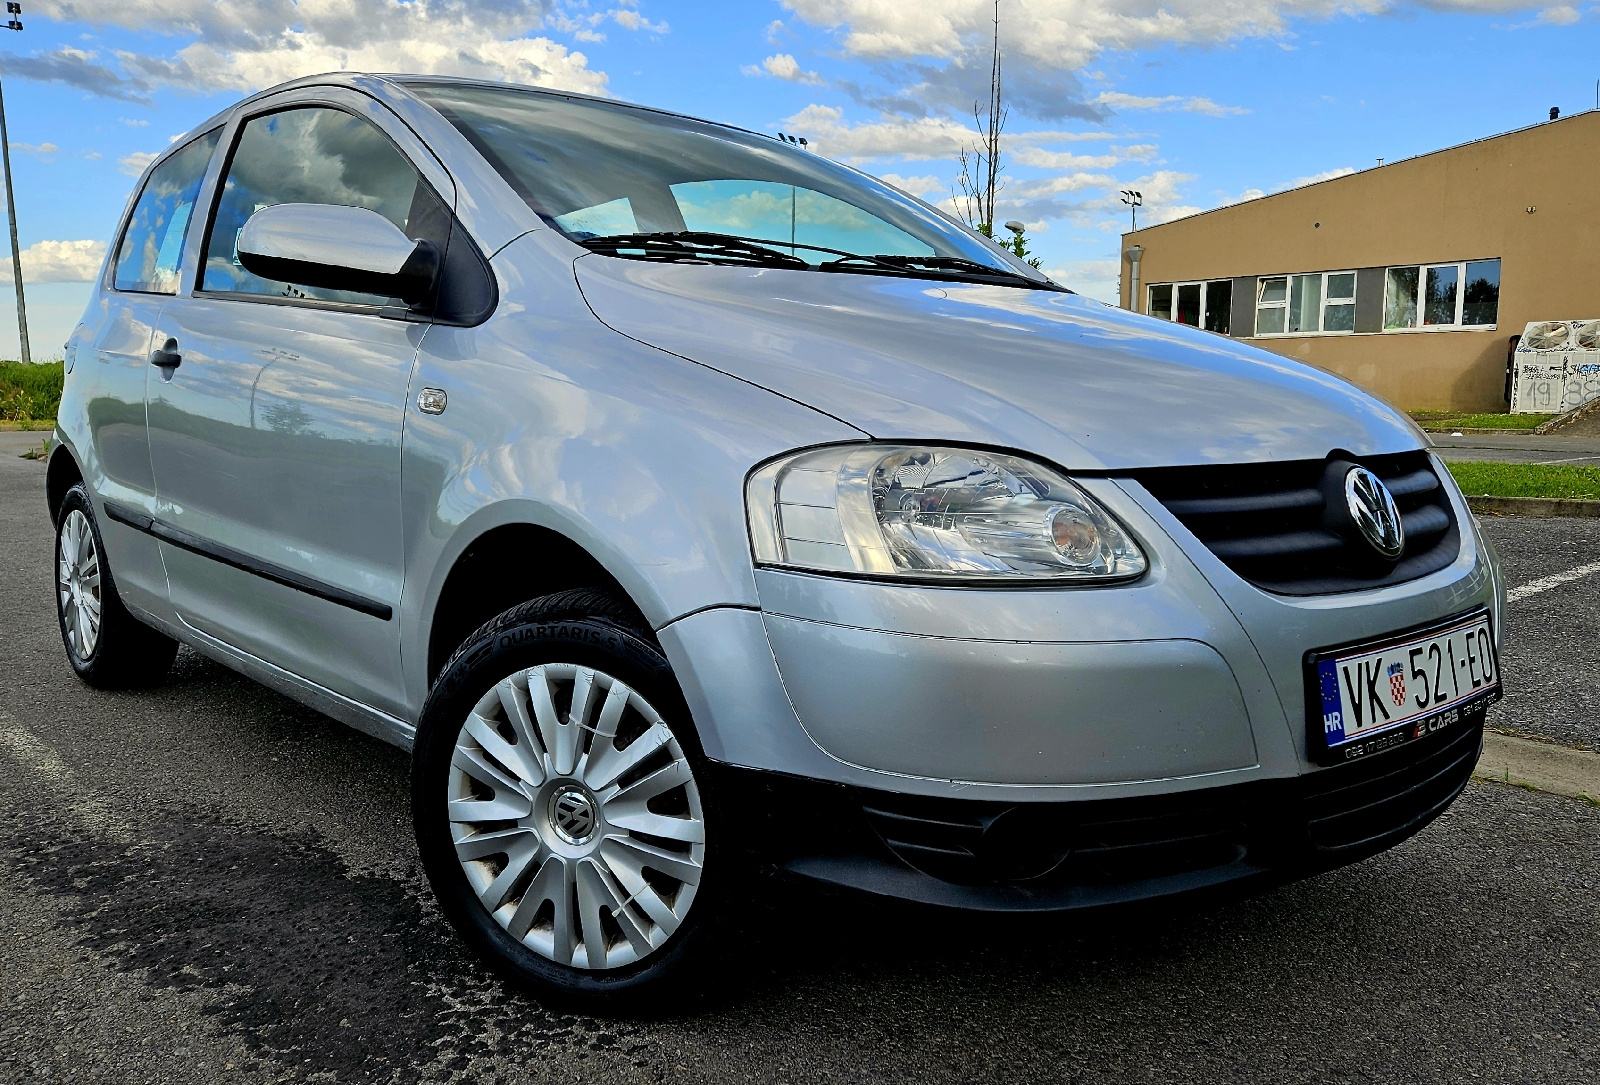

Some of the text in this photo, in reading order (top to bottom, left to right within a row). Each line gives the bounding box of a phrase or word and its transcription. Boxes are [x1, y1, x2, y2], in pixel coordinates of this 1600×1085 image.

[500, 626, 602, 649] QUARTARIS
[1343, 657, 1390, 728] VK
[1324, 711, 1342, 733] HR
[1428, 708, 1459, 732] CARS
